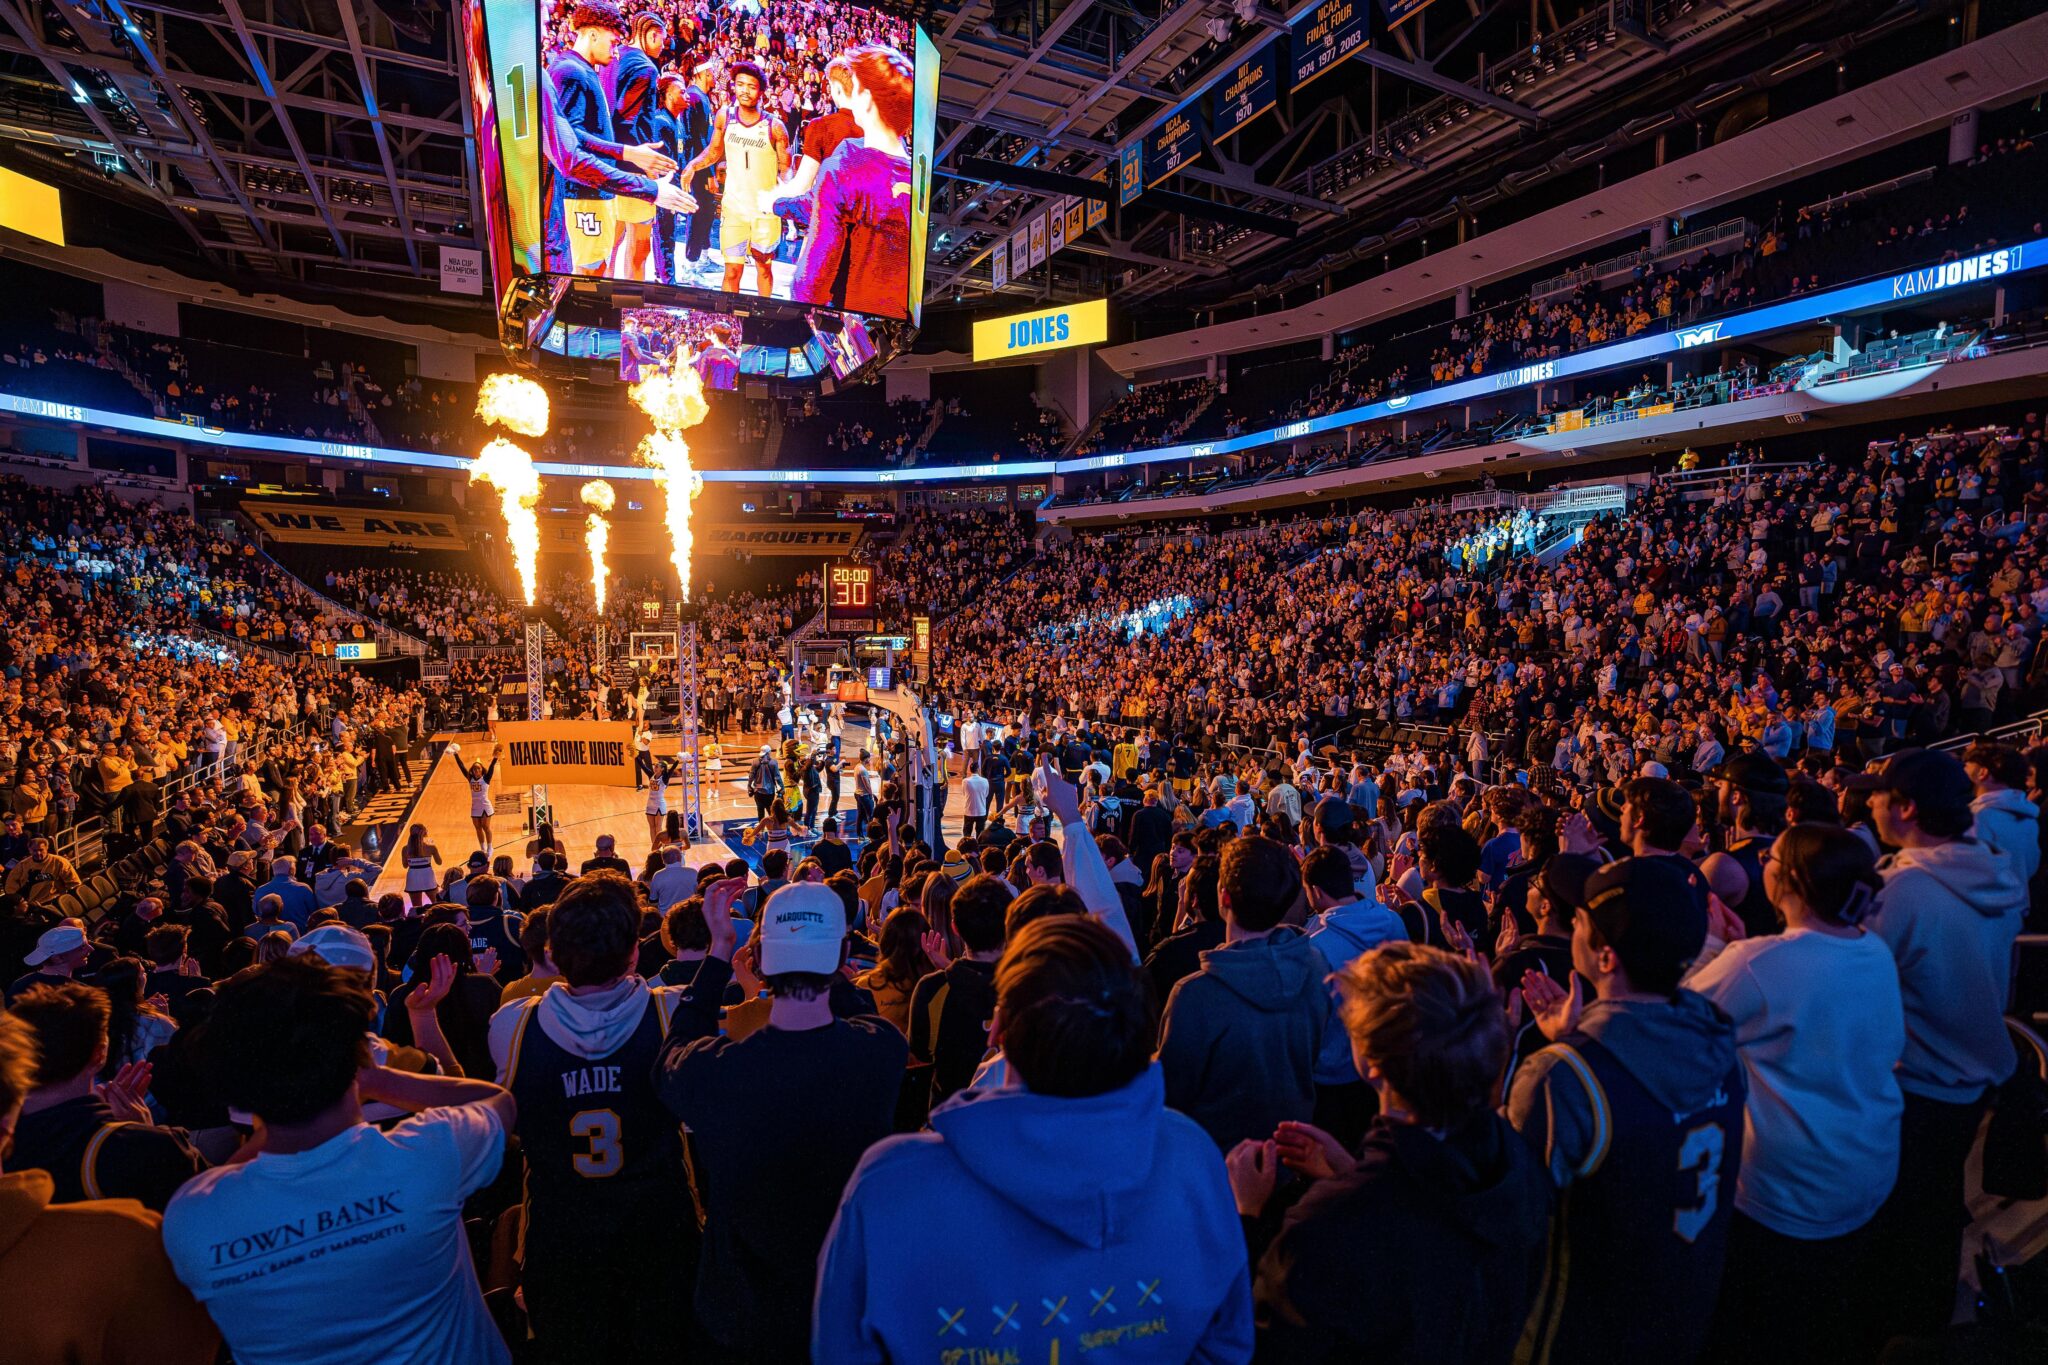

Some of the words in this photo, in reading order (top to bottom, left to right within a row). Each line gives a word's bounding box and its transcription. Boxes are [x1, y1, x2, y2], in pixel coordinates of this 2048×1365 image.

[1306, 20, 1329, 46] FINAL
[1330, 4, 1352, 29] FOUR
[1298, 60, 1315, 80] 1974
[1318, 46, 1336, 67] 1977
[1340, 30, 1361, 54] 2003
[1225, 65, 1263, 102] CHAMPIONS
[504, 63, 530, 140] 1
[1236, 102, 1253, 123] 1970
[1157, 119, 1190, 151] CHAMPIONS
[1123, 159, 1140, 190] 31
[1166, 152, 1181, 171] 1977
[916, 152, 928, 215] 1
[574, 211, 602, 237] MU
[1068, 208, 1081, 229] 14
[1032, 229, 1045, 253] 44
[443, 264, 479, 276] CHAMPIONS
[461, 259, 474, 268] CUP
[1008, 313, 1070, 349] JONES
[261, 512, 346, 532] WE
[364, 517, 456, 538] ARE
[708, 530, 851, 544] MARQUETTE
[833, 568, 868, 583] 20:00
[836, 582, 866, 605] 30
[644, 608, 659, 619] 30
[335, 645, 360, 658] ONES
[509, 740, 549, 766] MAKE
[550, 740, 587, 765] SOME
[589, 741, 625, 766] NOISE
[776, 911, 824, 925] MARQUETTE
[470, 937, 488, 949] ADE
[560, 1066, 623, 1098] WADE
[569, 1107, 625, 1178] 3
[1673, 1120, 1726, 1244] 3
[208, 1218, 305, 1266] TOWN
[316, 1189, 404, 1233] BANK
[211, 1264, 267, 1290] OFFICIAL
[270, 1253, 305, 1273] BANK
[309, 1245, 327, 1259] OF
[330, 1223, 407, 1252] MARQUETTE
